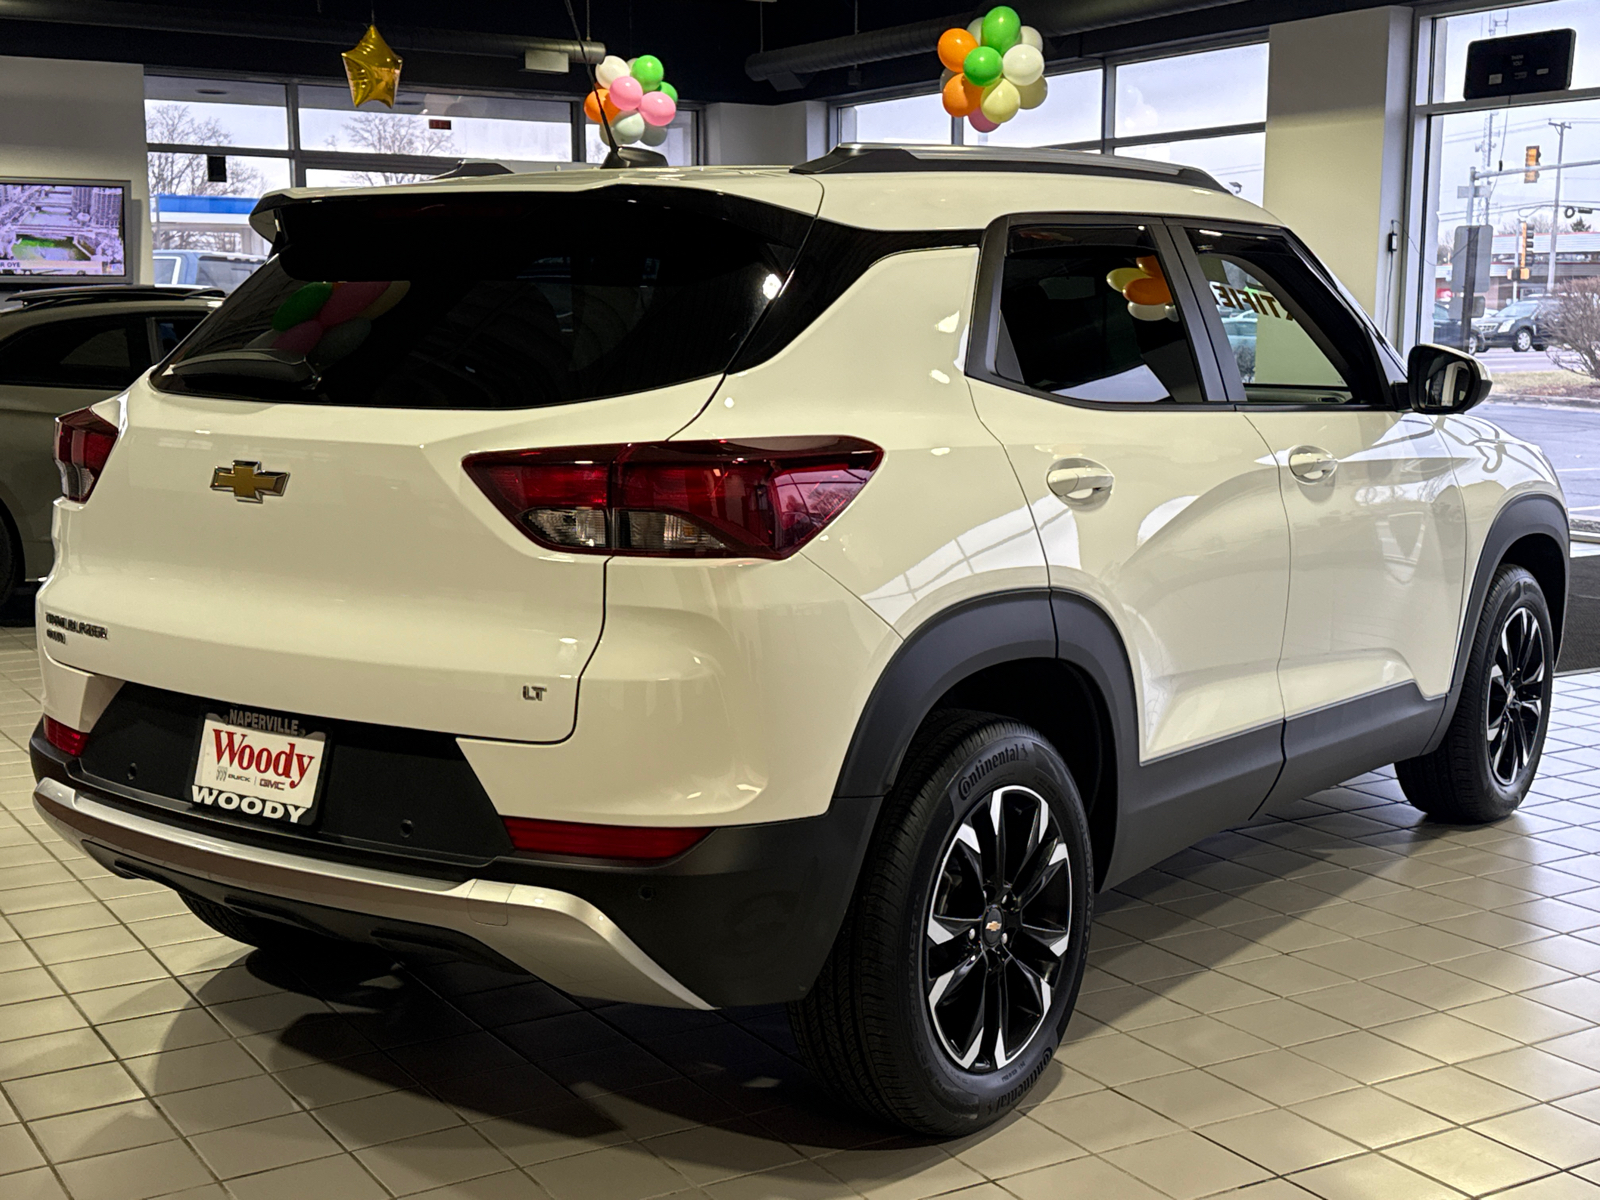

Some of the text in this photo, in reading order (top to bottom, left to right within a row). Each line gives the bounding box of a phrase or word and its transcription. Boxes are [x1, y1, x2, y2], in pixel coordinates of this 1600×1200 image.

[522, 685, 548, 701] LT
[229, 709, 299, 736] NAPERVILLE
[212, 728, 315, 789] Woody
[958, 743, 1020, 800] Continental
[227, 773, 286, 791] BUICK GMC
[191, 784, 308, 824] WOODY
[996, 1046, 1053, 1113] Continental
